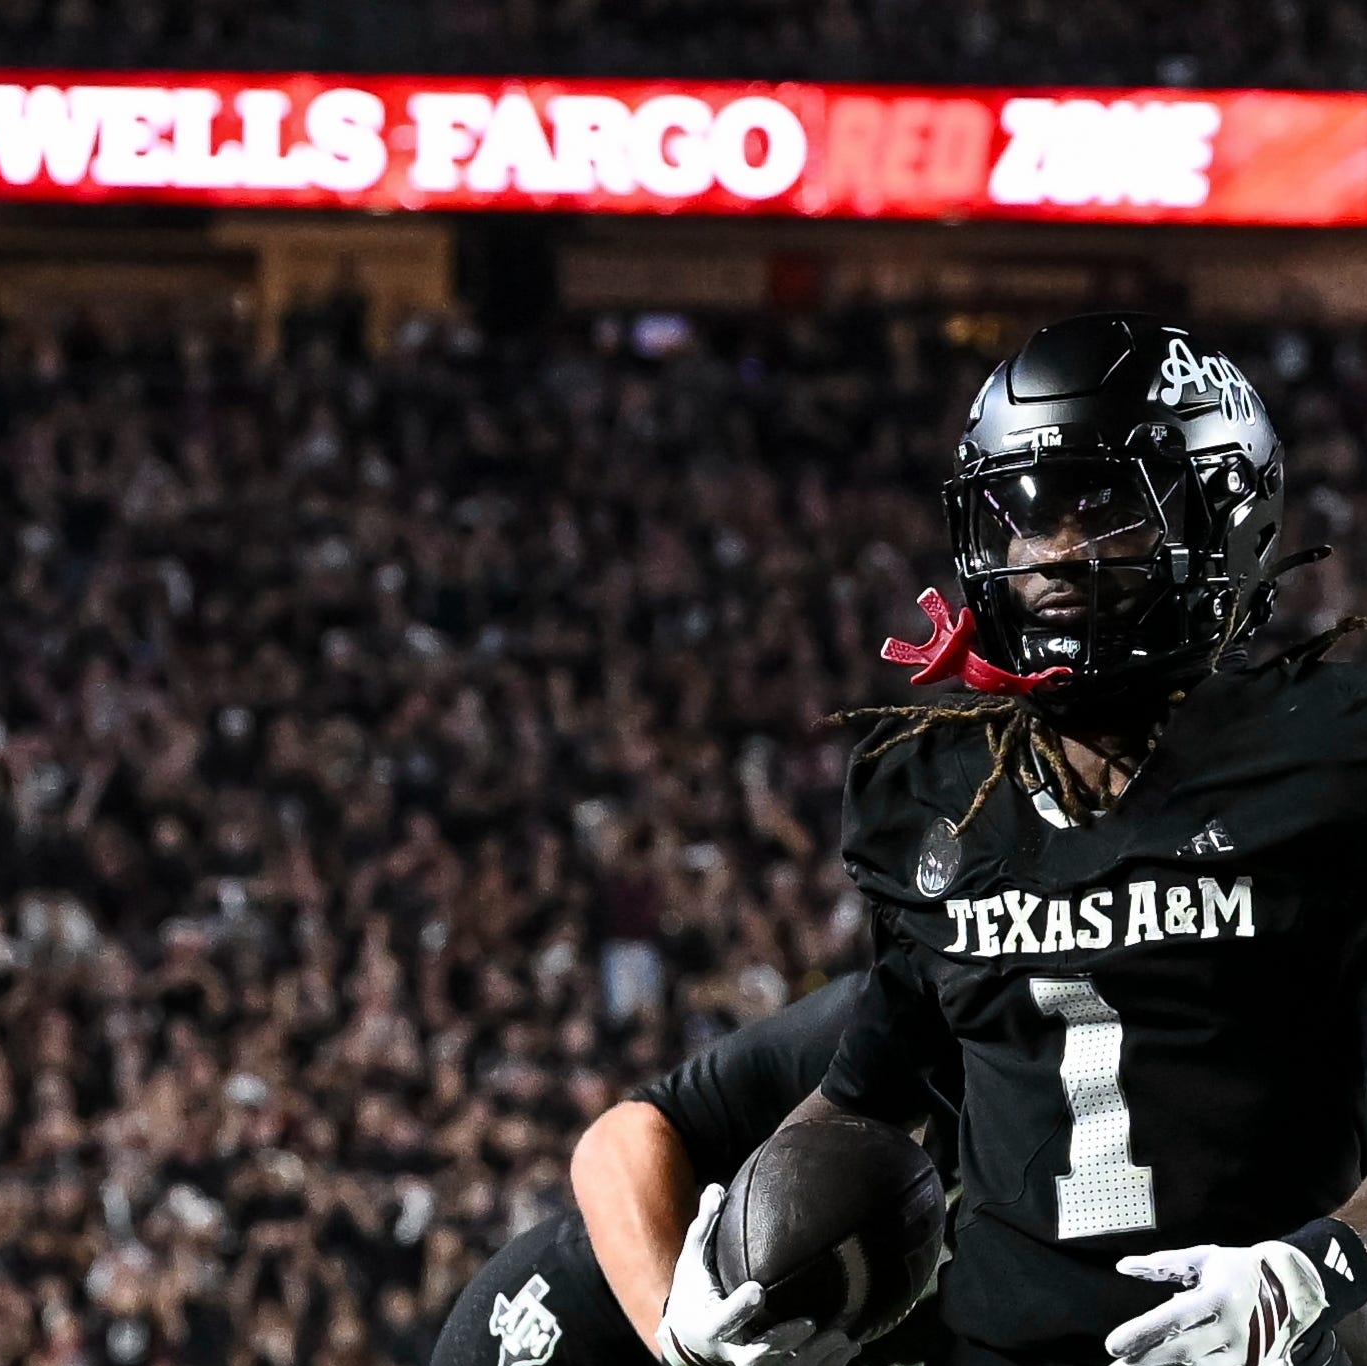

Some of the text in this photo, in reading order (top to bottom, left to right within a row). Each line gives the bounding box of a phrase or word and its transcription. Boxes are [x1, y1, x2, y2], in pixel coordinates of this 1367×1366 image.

[409, 93, 807, 198] FARGO
[832, 97, 994, 203] RED
[988, 99, 1220, 206] ZONE
[1160, 338, 1256, 429] Agg
[943, 876, 1256, 957] TEXAS A&M
[1029, 973, 1157, 1240] 1
